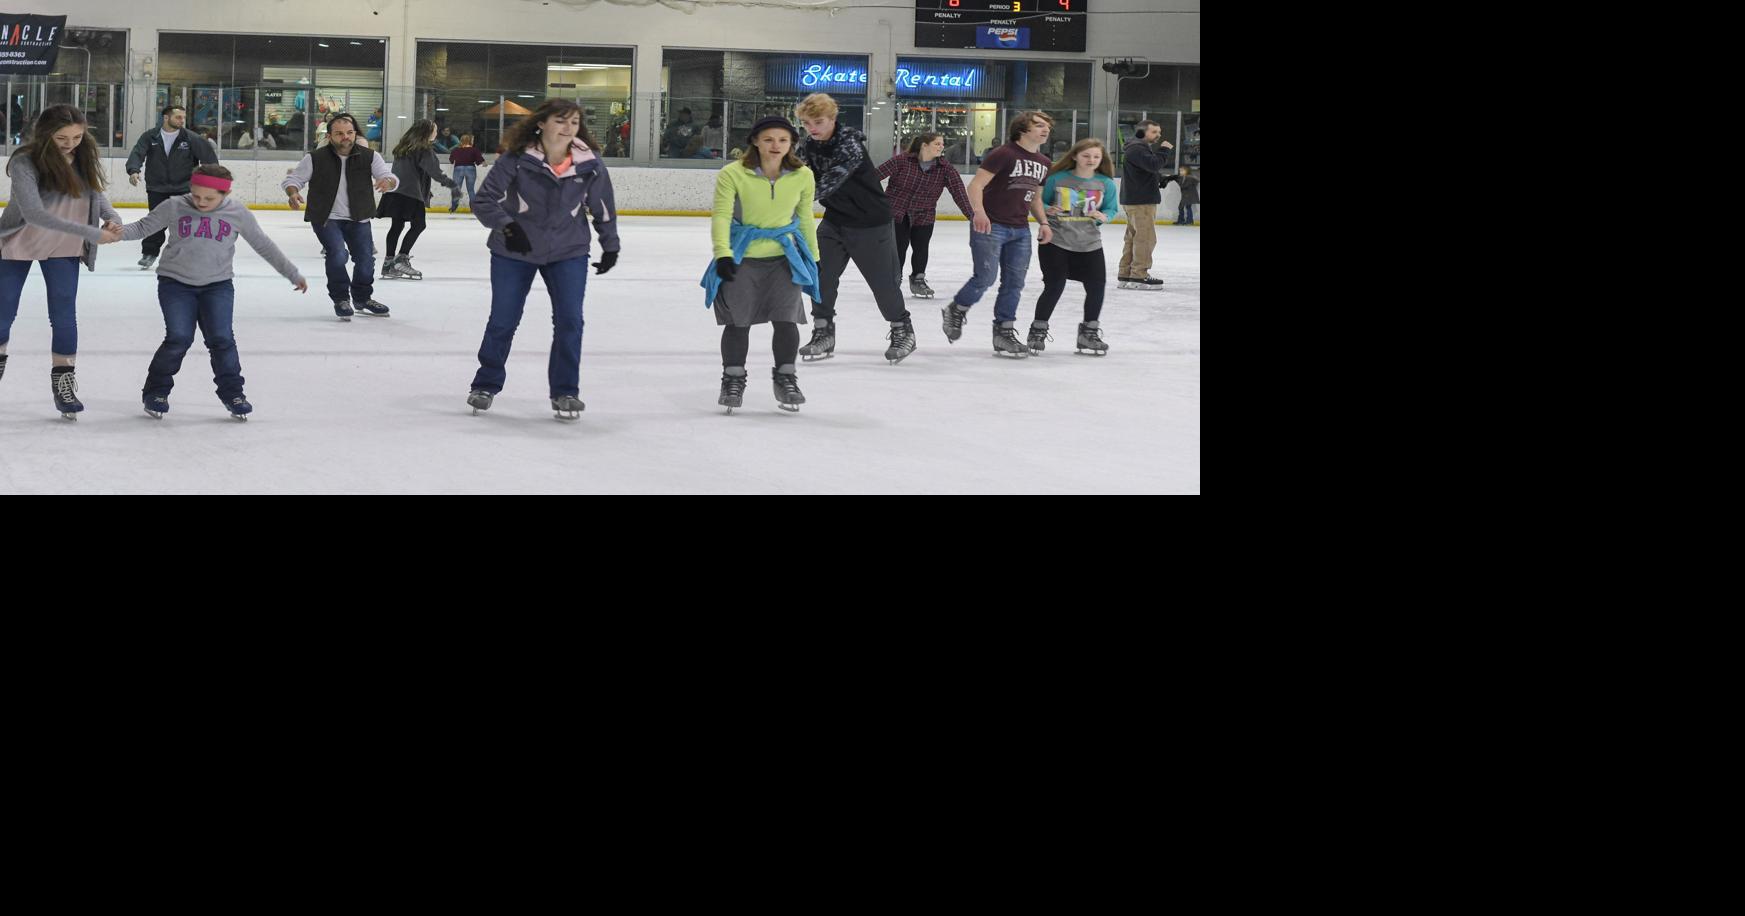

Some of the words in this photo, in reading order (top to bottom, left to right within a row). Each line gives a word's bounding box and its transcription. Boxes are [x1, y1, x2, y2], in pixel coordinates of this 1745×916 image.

[1013, 1, 1021, 12] 3
[987, 28, 1018, 36] PEPSI
[803, 65, 867, 86] Skate
[895, 68, 975, 88] Rental
[178, 215, 231, 242] GAP
